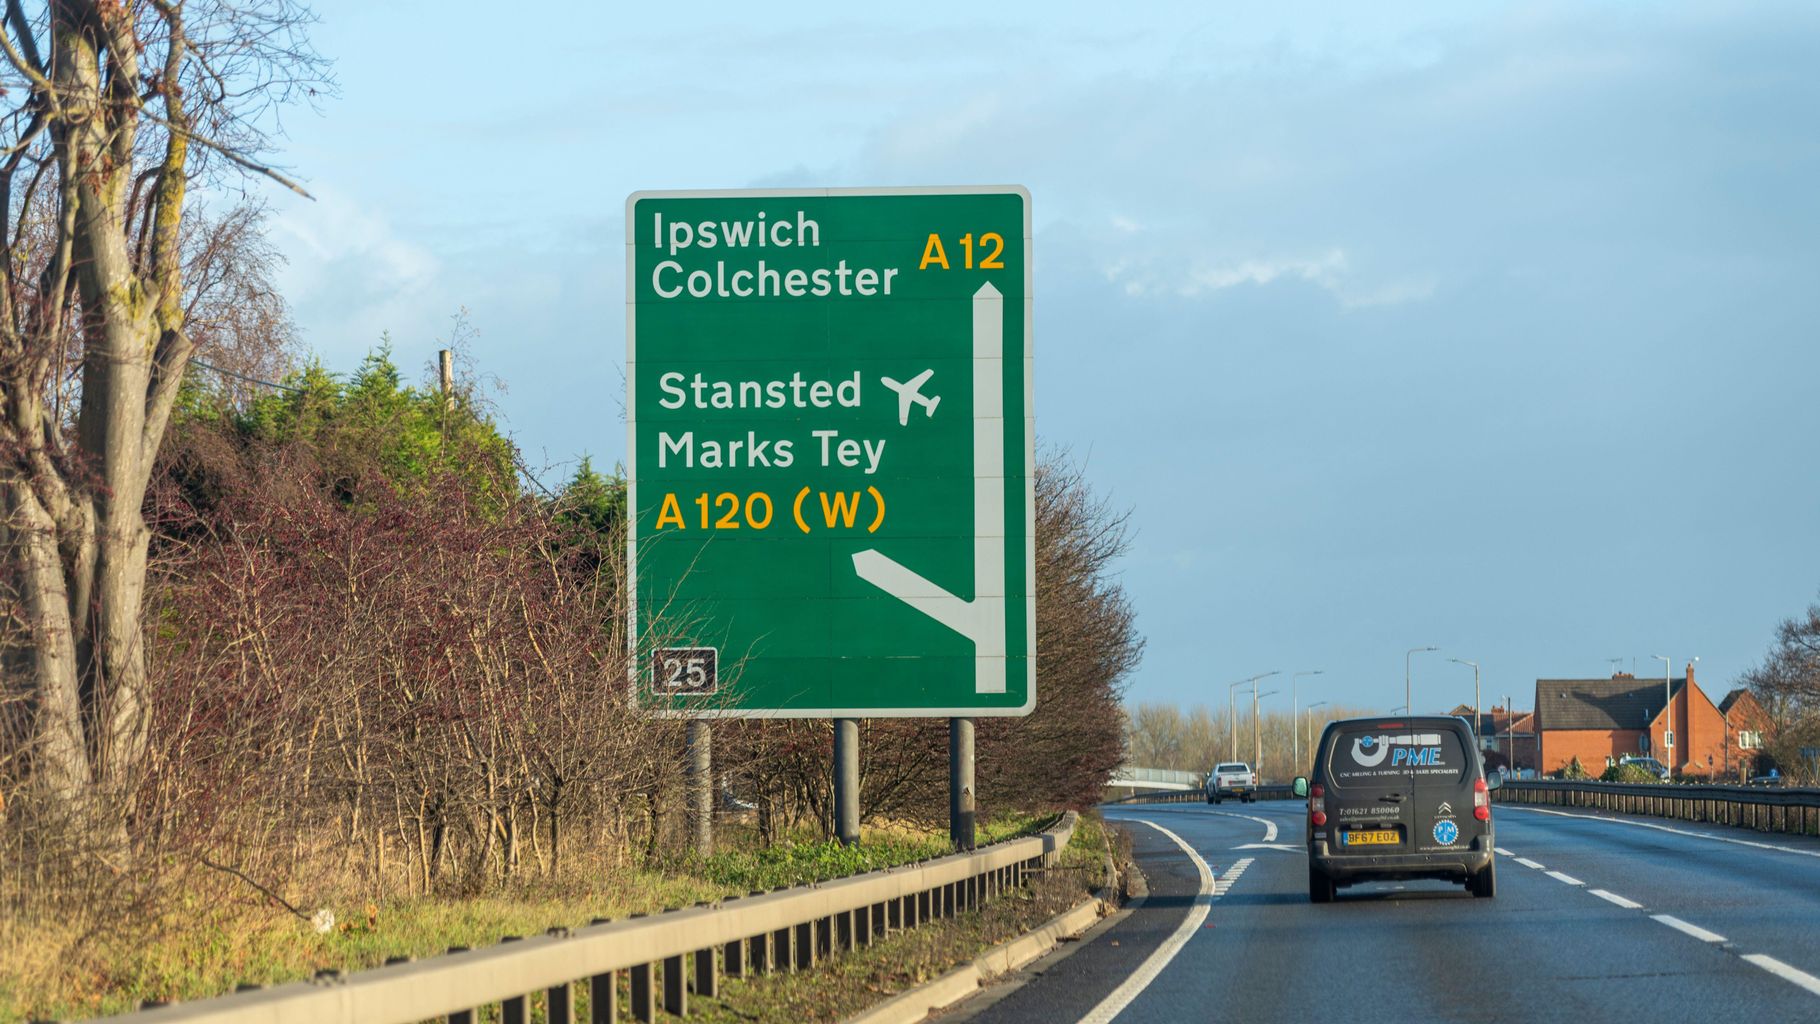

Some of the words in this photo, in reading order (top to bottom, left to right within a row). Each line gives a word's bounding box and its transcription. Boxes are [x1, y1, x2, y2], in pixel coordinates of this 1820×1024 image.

[653, 211, 820, 256] Ipswich
[652, 260, 898, 299] Colchester
[659, 371, 861, 410] Stansted
[658, 432, 794, 468] Marks
[812, 430, 886, 474] Tey
[793, 486, 886, 534] (W)
[664, 658, 706, 687] 25
[1391, 747, 1441, 766] PME
[1348, 833, 1374, 843] BF67
